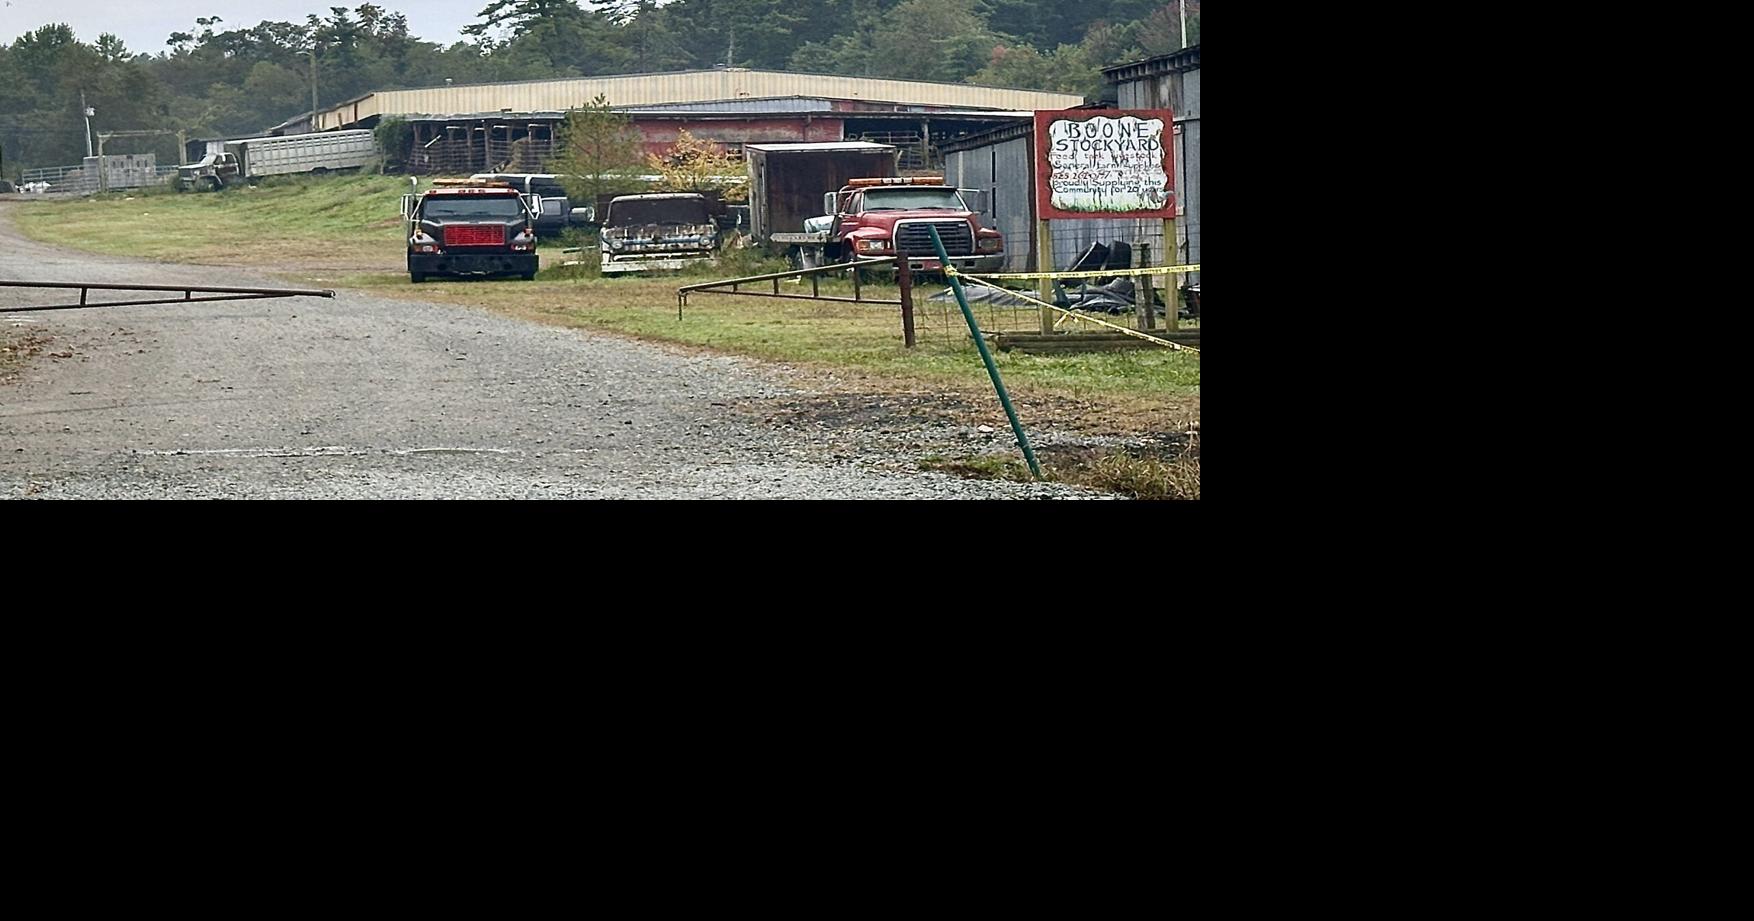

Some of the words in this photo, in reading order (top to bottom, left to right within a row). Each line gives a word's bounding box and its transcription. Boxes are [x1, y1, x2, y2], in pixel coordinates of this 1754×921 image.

[1068, 122, 1148, 138] BOONE
[1056, 139, 1159, 152] STOCKYARD
[1053, 179, 1089, 189] proudly
[1144, 177, 1162, 186] this
[1111, 186, 1123, 196] for
